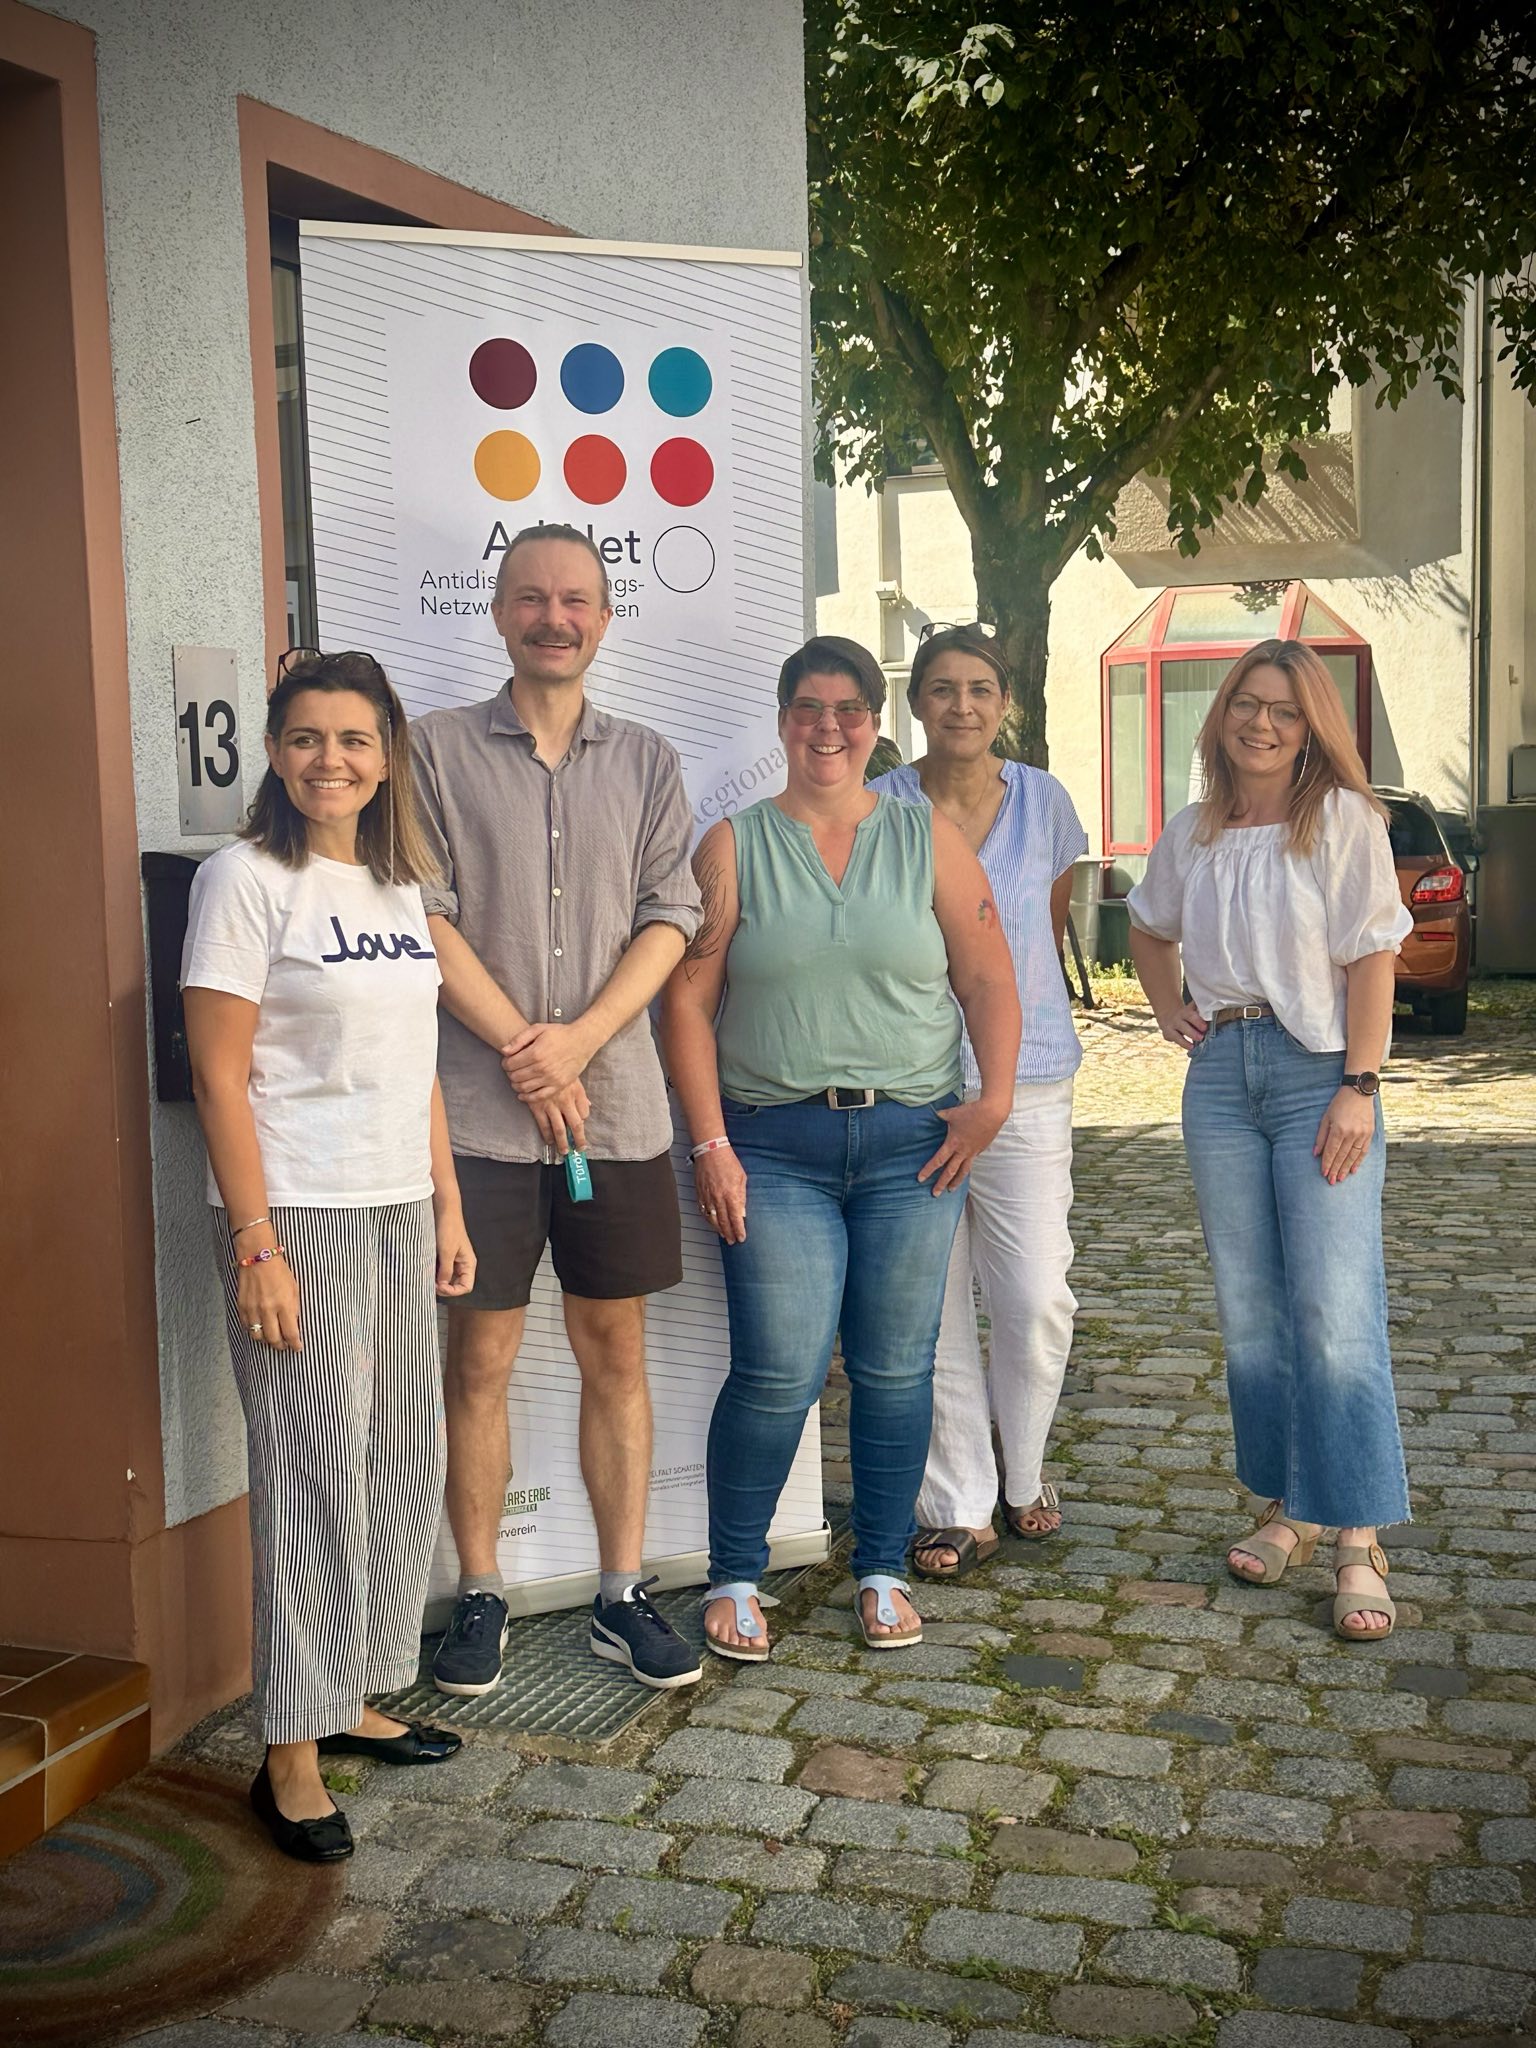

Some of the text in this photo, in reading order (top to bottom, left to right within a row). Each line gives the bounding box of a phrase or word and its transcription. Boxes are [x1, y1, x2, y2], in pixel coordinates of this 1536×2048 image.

[421, 596, 490, 615] Netzw
[180, 699, 239, 788] 13
[528, 1486, 551, 1503] ERBE
